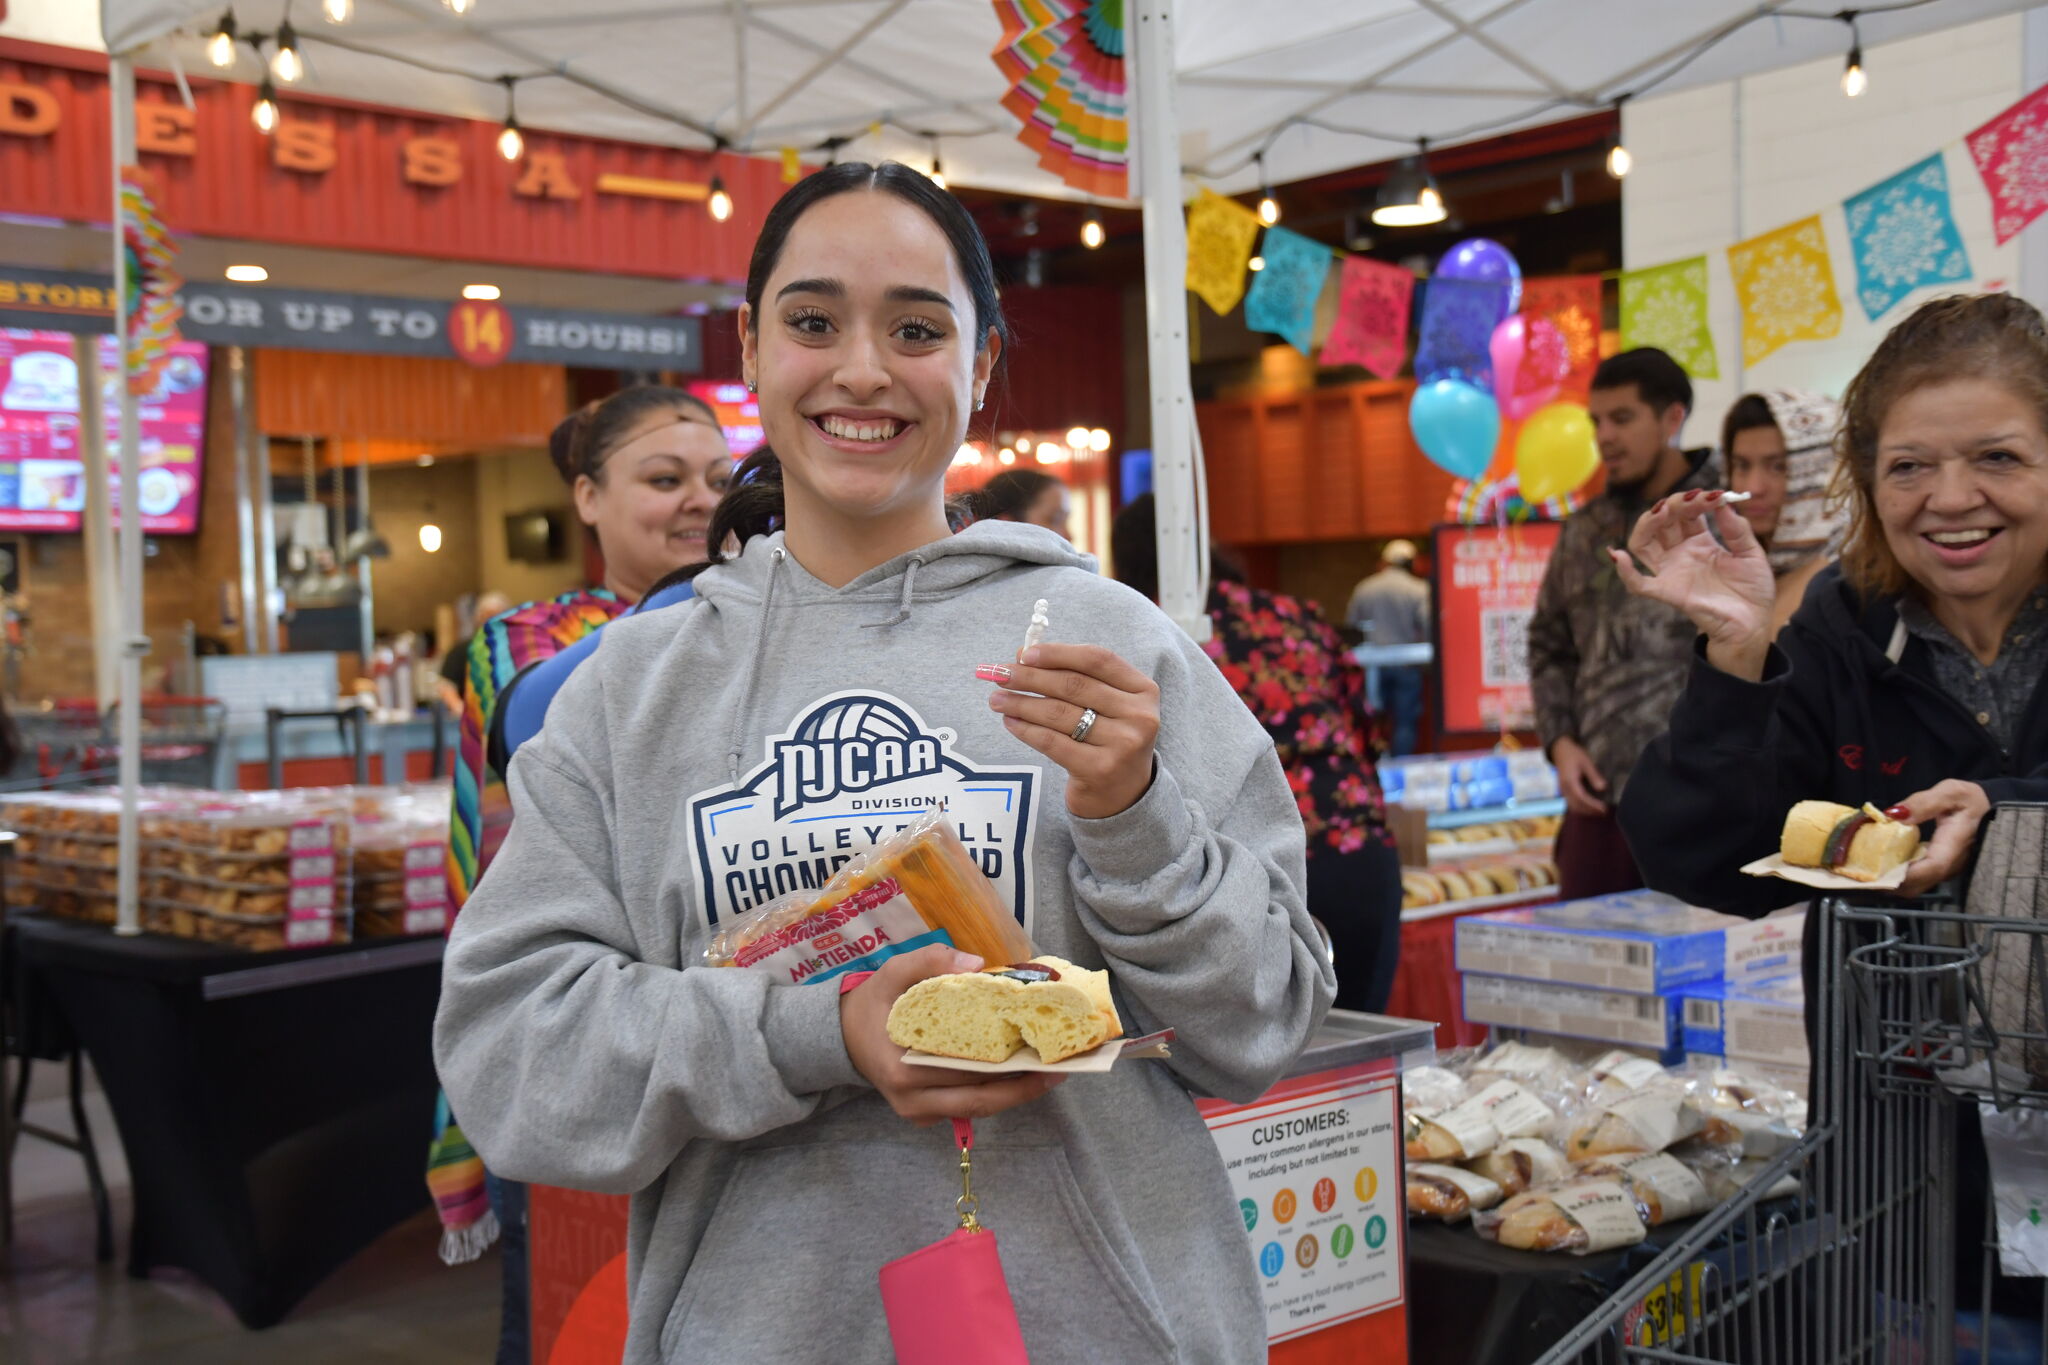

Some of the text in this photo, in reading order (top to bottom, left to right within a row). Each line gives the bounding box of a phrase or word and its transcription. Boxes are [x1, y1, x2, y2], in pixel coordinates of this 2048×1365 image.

[176, 296, 263, 329] OR
[282, 302, 354, 333] UP
[369, 307, 437, 340] TO
[459, 305, 503, 354] 14
[526, 319, 688, 356] HOURS!
[776, 738, 940, 819] NJCAA
[852, 795, 937, 811] DIVISION
[722, 823, 1002, 867] VOLLEYLL
[789, 959, 816, 983] MI
[817, 927, 890, 968] TIENDA
[1226, 1160, 1242, 1169] use
[1244, 1153, 1268, 1165] many
[1270, 1143, 1306, 1159] common
[1308, 1133, 1345, 1150] allergens
[1356, 1128, 1369, 1138] our
[1371, 1122, 1394, 1134] store,
[1252, 1109, 1350, 1146] CUSTOMERS:
[1248, 1164, 1287, 1181] including
[1289, 1158, 1303, 1170] but
[1305, 1155, 1319, 1166] not
[1321, 1148, 1348, 1163] limited
[1289, 1305, 1311, 1319] Thank
